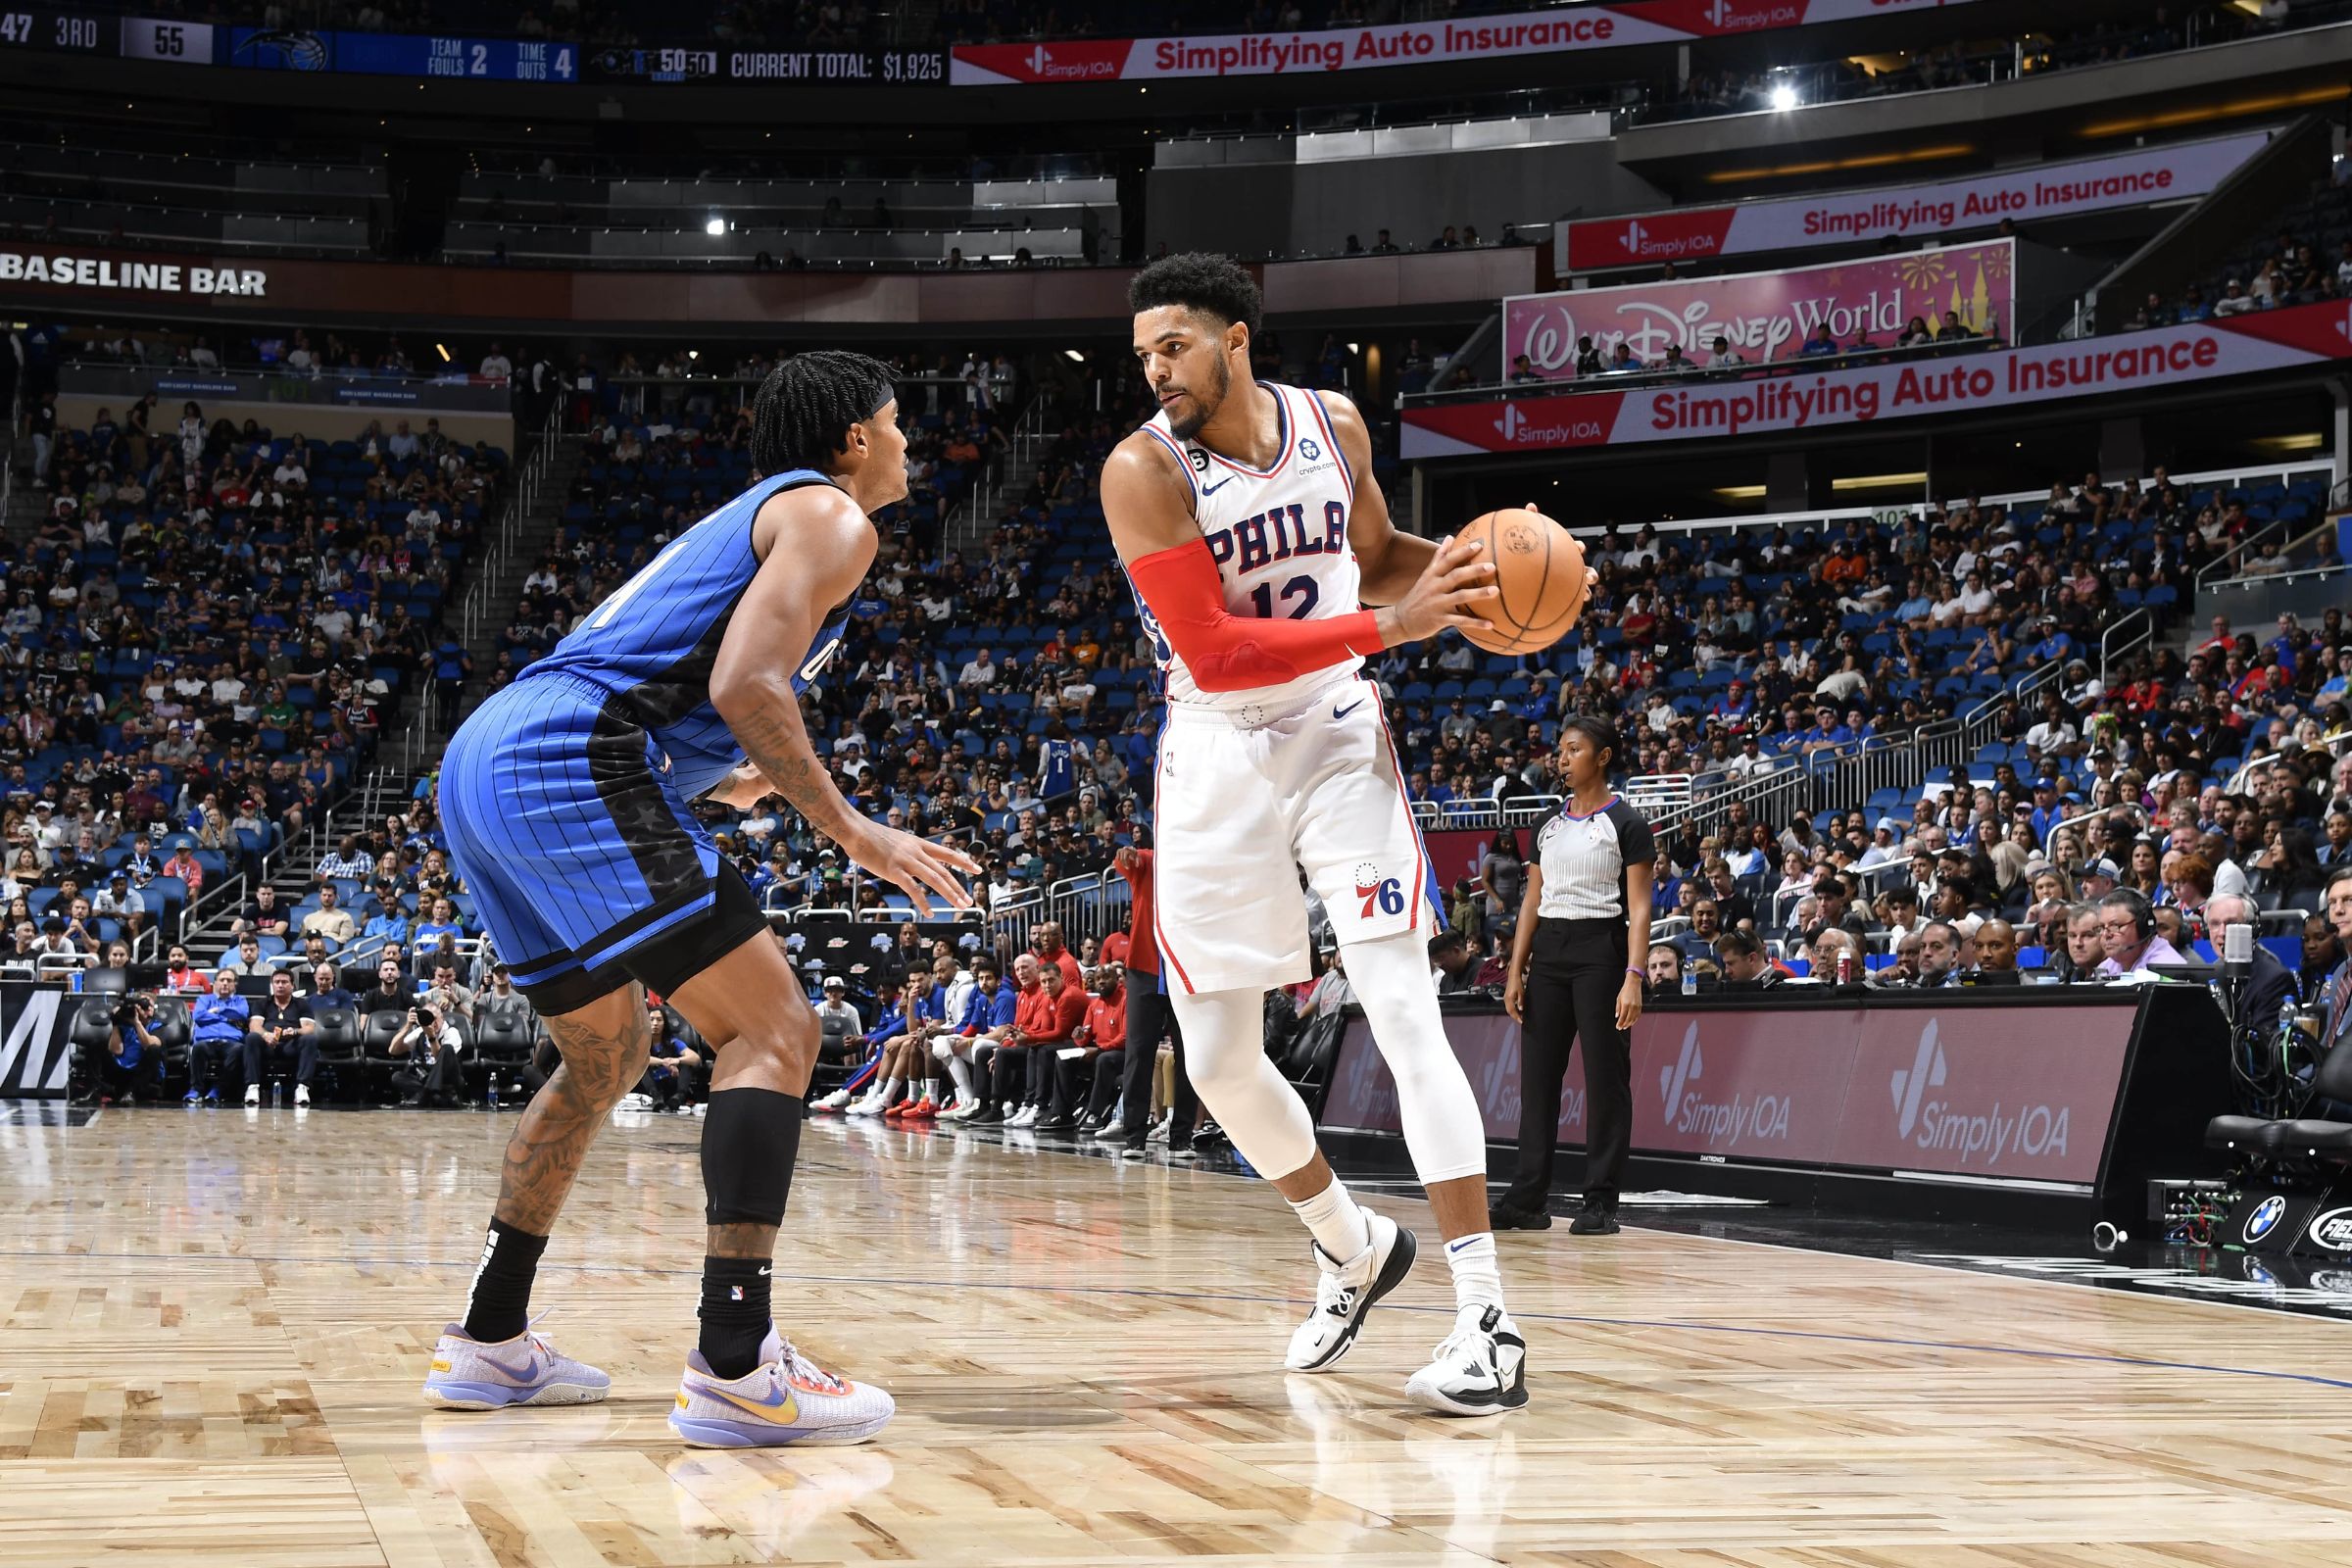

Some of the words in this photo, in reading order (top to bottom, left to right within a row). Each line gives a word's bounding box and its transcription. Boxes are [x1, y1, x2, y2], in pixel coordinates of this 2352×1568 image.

[56, 18, 97, 48] 3RD
[155, 25, 183, 56] 55
[431, 38, 462, 57] TEAM
[517, 42, 547, 61] TIME
[1155, 36, 1344, 71] Simplifying
[1353, 31, 1434, 60] Auto
[1446, 18, 1614, 53] Insurance
[428, 58, 464, 76] FOULS
[470, 44, 487, 74] 2
[517, 61, 546, 79] OUTS
[554, 48, 571, 78] 4
[730, 53, 812, 78] CURRENT
[815, 53, 873, 78] TOTAL:
[883, 52, 942, 83] $1,925
[1045, 64, 1089, 78] Simply
[1641, 239, 1687, 256] Simply
[1803, 201, 1955, 236] Simplifying
[1962, 188, 2027, 217] Auto
[2035, 169, 2173, 207] Insurance
[0, 253, 181, 292] BASELINE
[189, 267, 267, 296] BAR
[1789, 287, 1904, 342] World
[1517, 425, 1569, 445] Simply
[1651, 376, 1881, 436] Simplifying
[1891, 367, 1994, 408] Auto
[2007, 336, 2219, 393] Insurance
[1189, 451, 1205, 470] 6
[1298, 462, 1337, 476] crypto.com
[1204, 500, 1345, 576] PHILA
[1250, 574, 1319, 619] 12
[1355, 877, 1404, 919] 76
[1495, 1086, 1522, 1122] Sim
[1677, 1092, 1750, 1147] Simply
[1917, 1101, 2014, 1165] Simply
